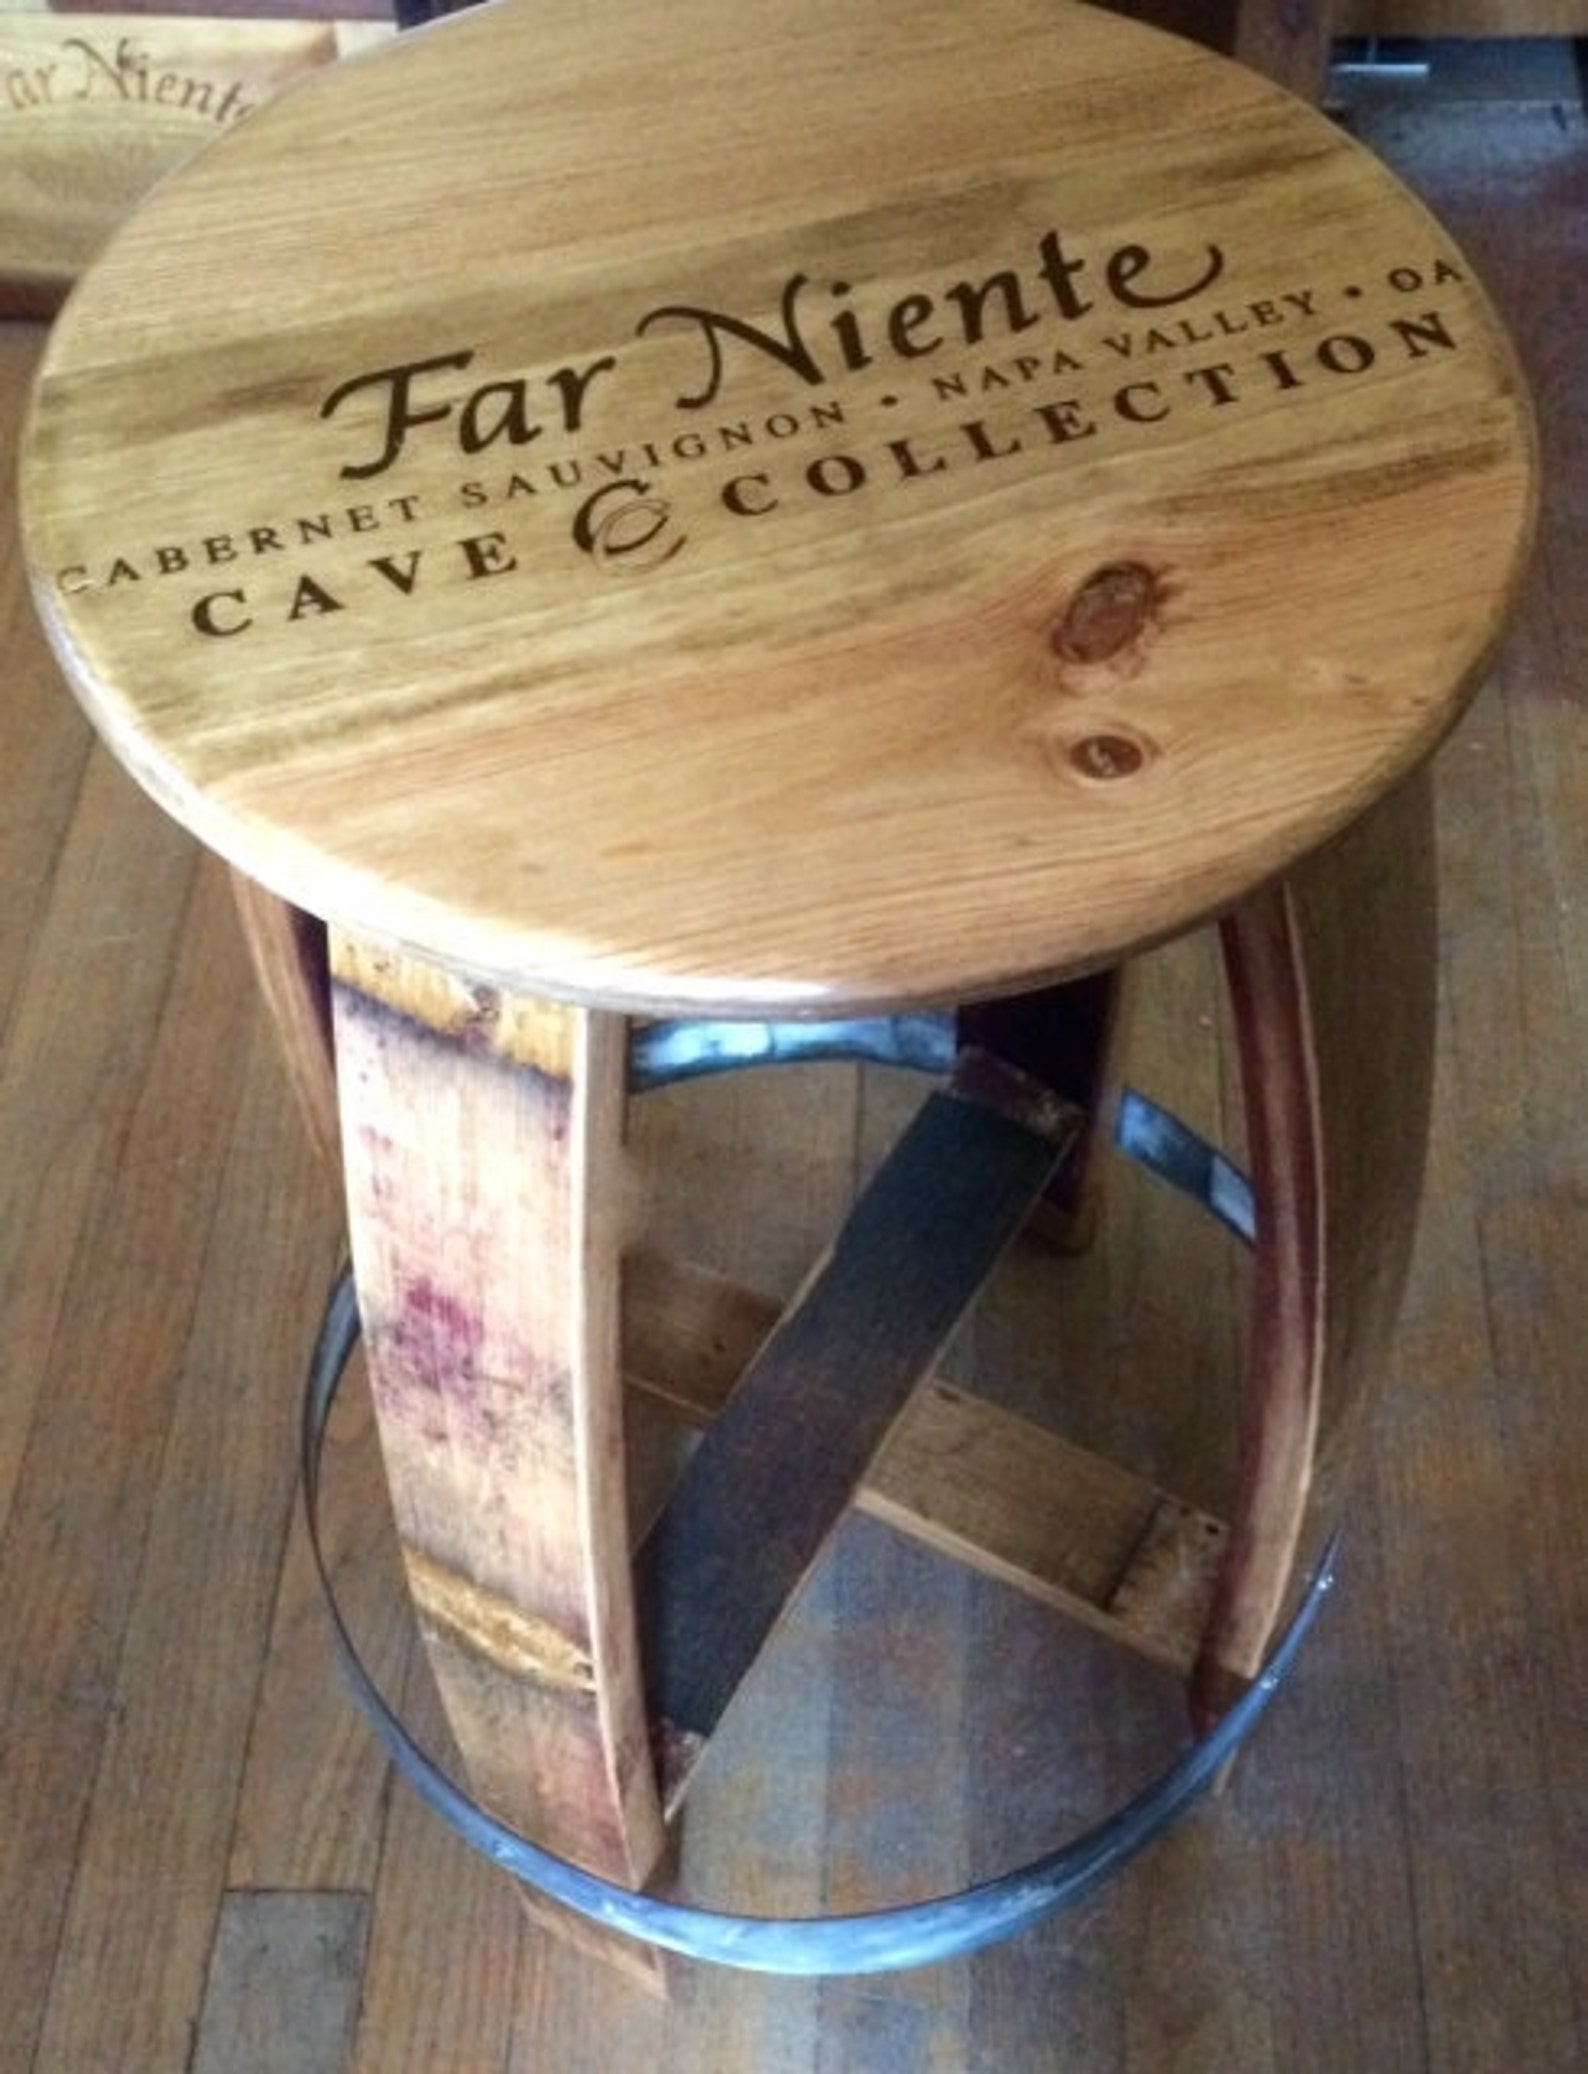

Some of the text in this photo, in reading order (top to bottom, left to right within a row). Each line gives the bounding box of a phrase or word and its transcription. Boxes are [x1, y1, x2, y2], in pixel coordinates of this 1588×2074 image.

[56, 494, 421, 596] CABERNET
[461, 400, 845, 507] SAUVIGNON
[931, 350, 1084, 402] NAPA
[1102, 289, 1320, 360] VALLEY
[190, 530, 518, 637] CAVE
[721, 311, 1457, 517] COLLECTION
[319, 228, 1224, 481] Far Niente
